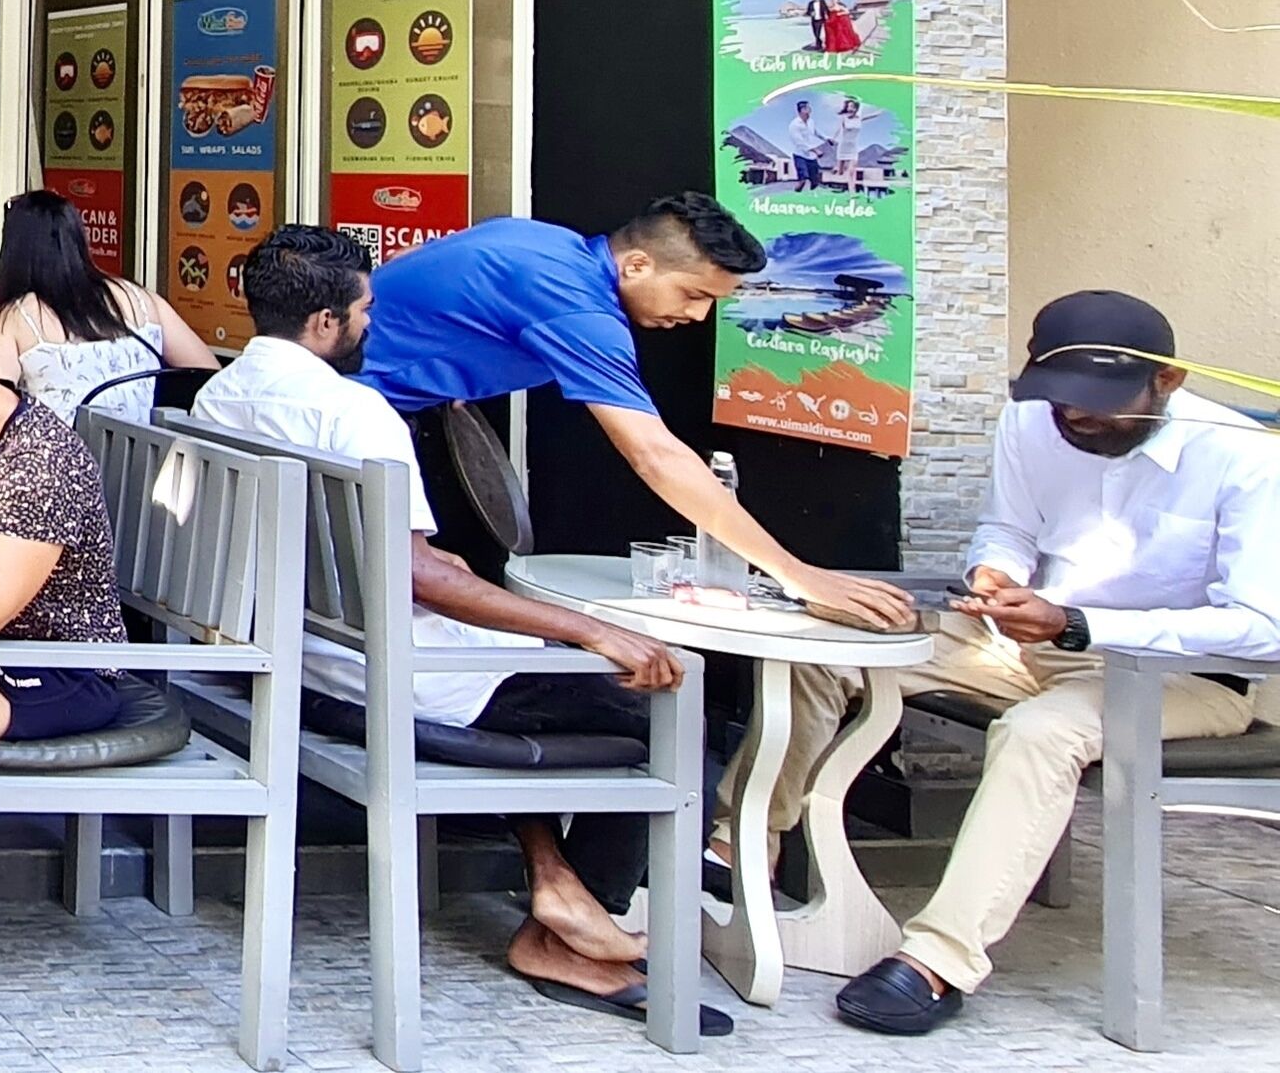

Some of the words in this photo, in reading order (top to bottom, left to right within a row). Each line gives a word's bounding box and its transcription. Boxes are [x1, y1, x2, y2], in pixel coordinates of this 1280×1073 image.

[750, 55, 786, 72] Club
[792, 52, 832, 71] Med
[231, 145, 262, 155] SALADS
[749, 197, 820, 215] Adaaran
[81, 209, 106, 225] CAN
[108, 210, 117, 225] &
[85, 226, 118, 245] RDER
[747, 413, 873, 444] www.uimaldives.com
